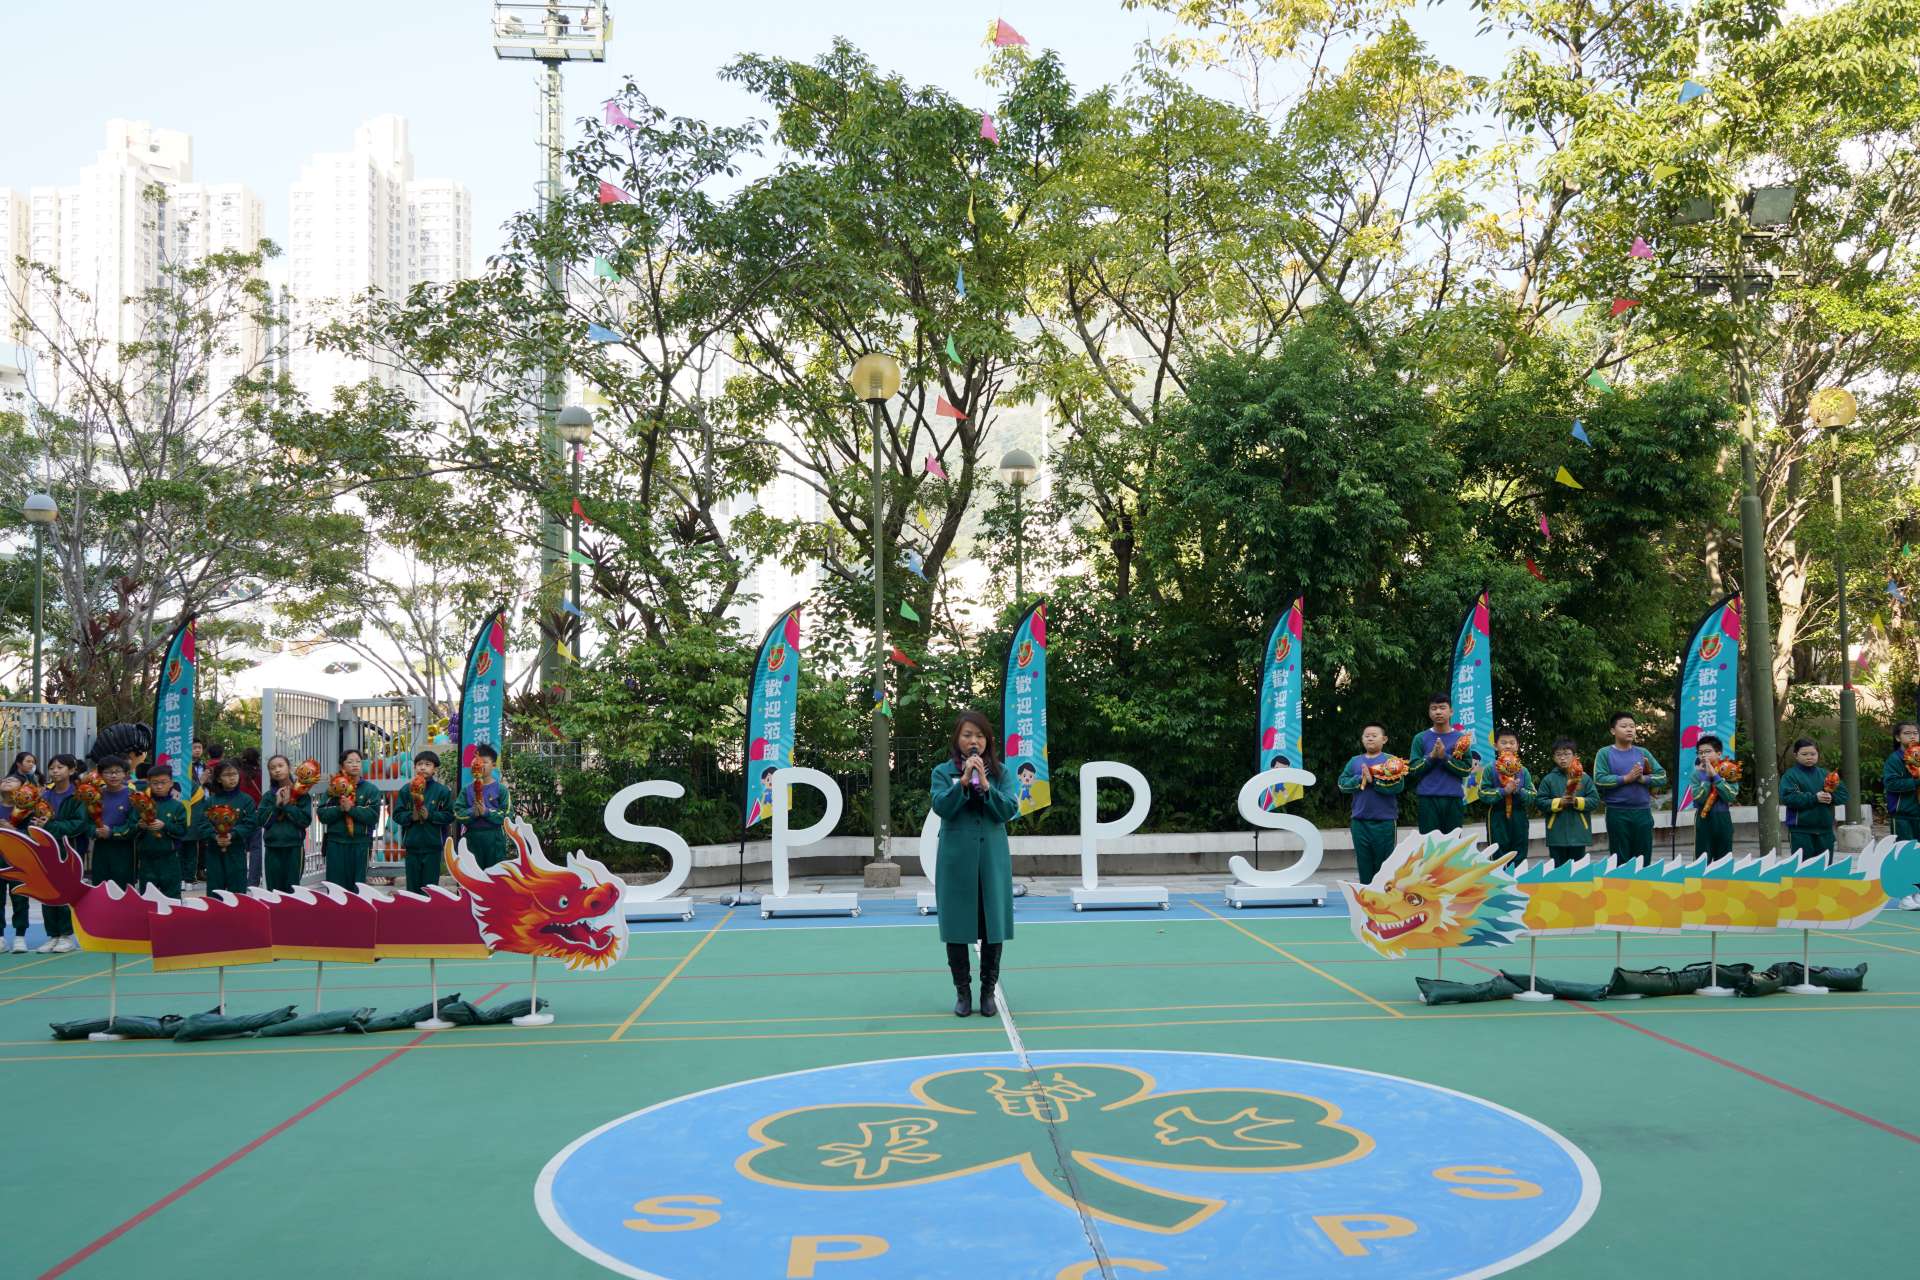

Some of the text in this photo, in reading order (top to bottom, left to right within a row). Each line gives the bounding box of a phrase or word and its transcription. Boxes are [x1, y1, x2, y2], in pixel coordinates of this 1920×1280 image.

[473, 684, 490, 745] 歡迎蒞
[763, 678, 782, 761] 歡迎蒞臨
[1016, 675, 1034, 757] 歡迎蒞臨
[1272, 668, 1289, 750] 歡迎蒞臨
[1698, 668, 1718, 737] 歡迎蒞
